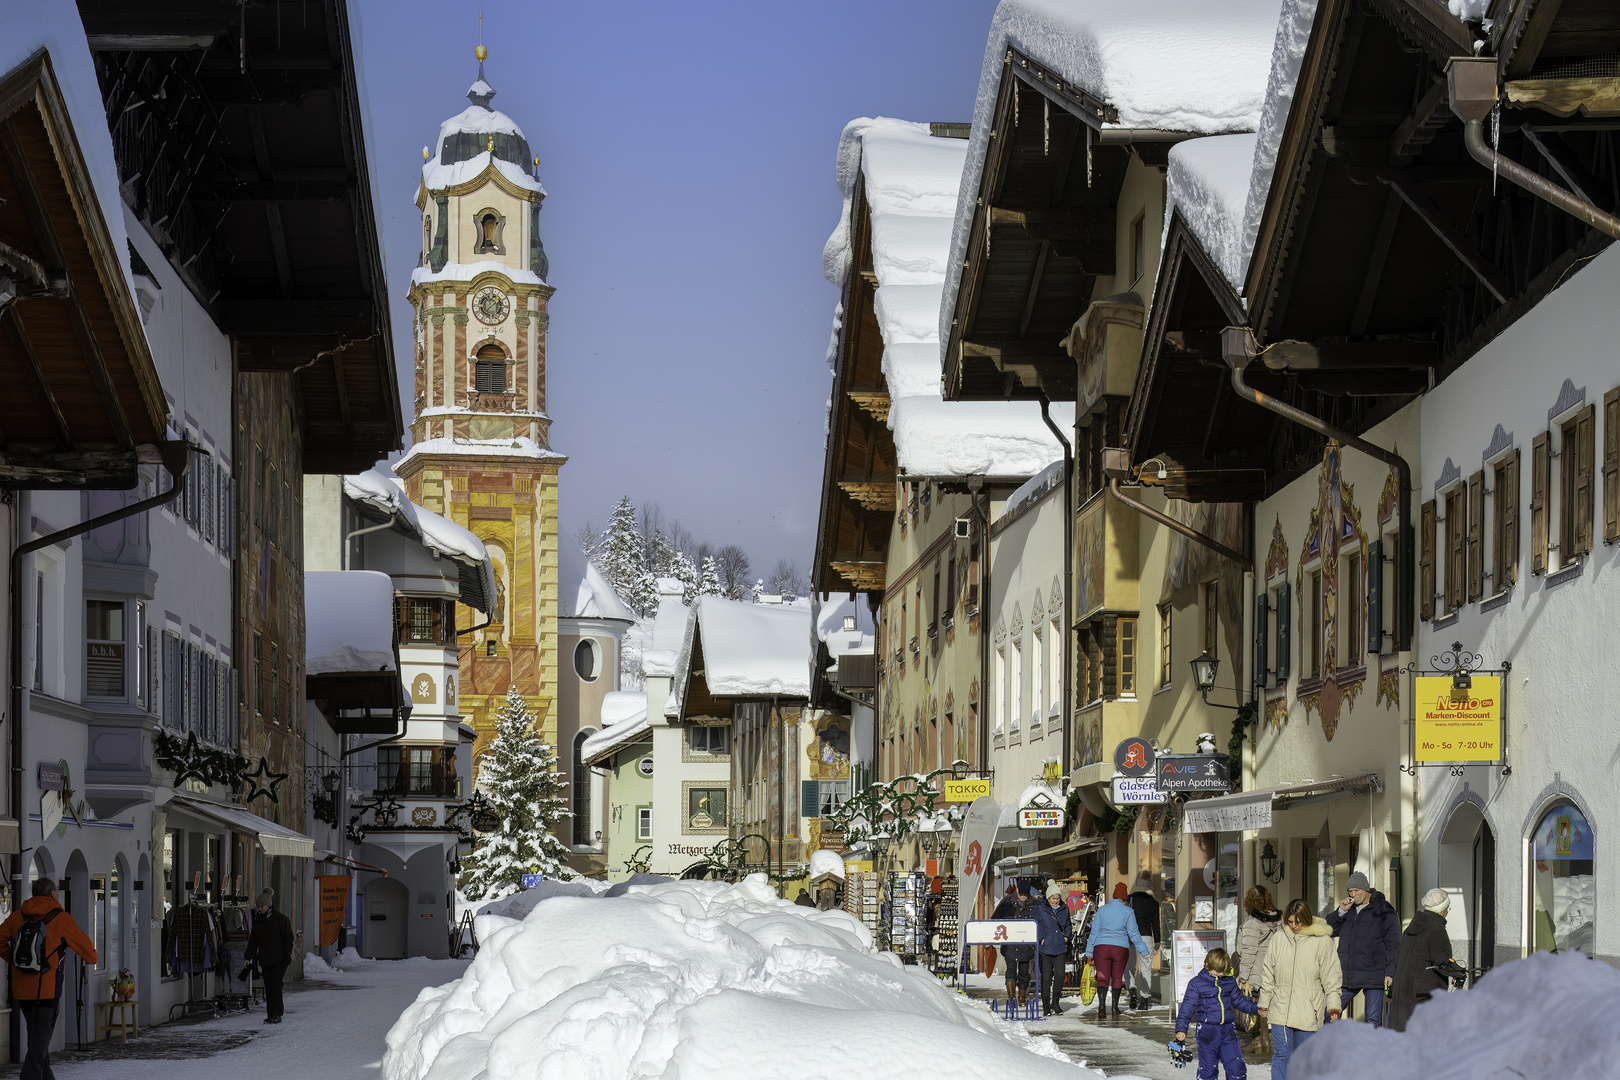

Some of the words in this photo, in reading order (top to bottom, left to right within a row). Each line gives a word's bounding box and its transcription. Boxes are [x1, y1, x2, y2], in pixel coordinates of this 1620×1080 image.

[92, 646, 116, 656] b.b.h.
[1436, 695, 1480, 710] Netto
[1425, 711, 1491, 719] Marken-Discount
[1479, 741, 1493, 749] Uhr
[1161, 778, 1187, 788] Alpen
[1187, 778, 1228, 788] Apotheke
[1122, 791, 1160, 801] Wörnle
